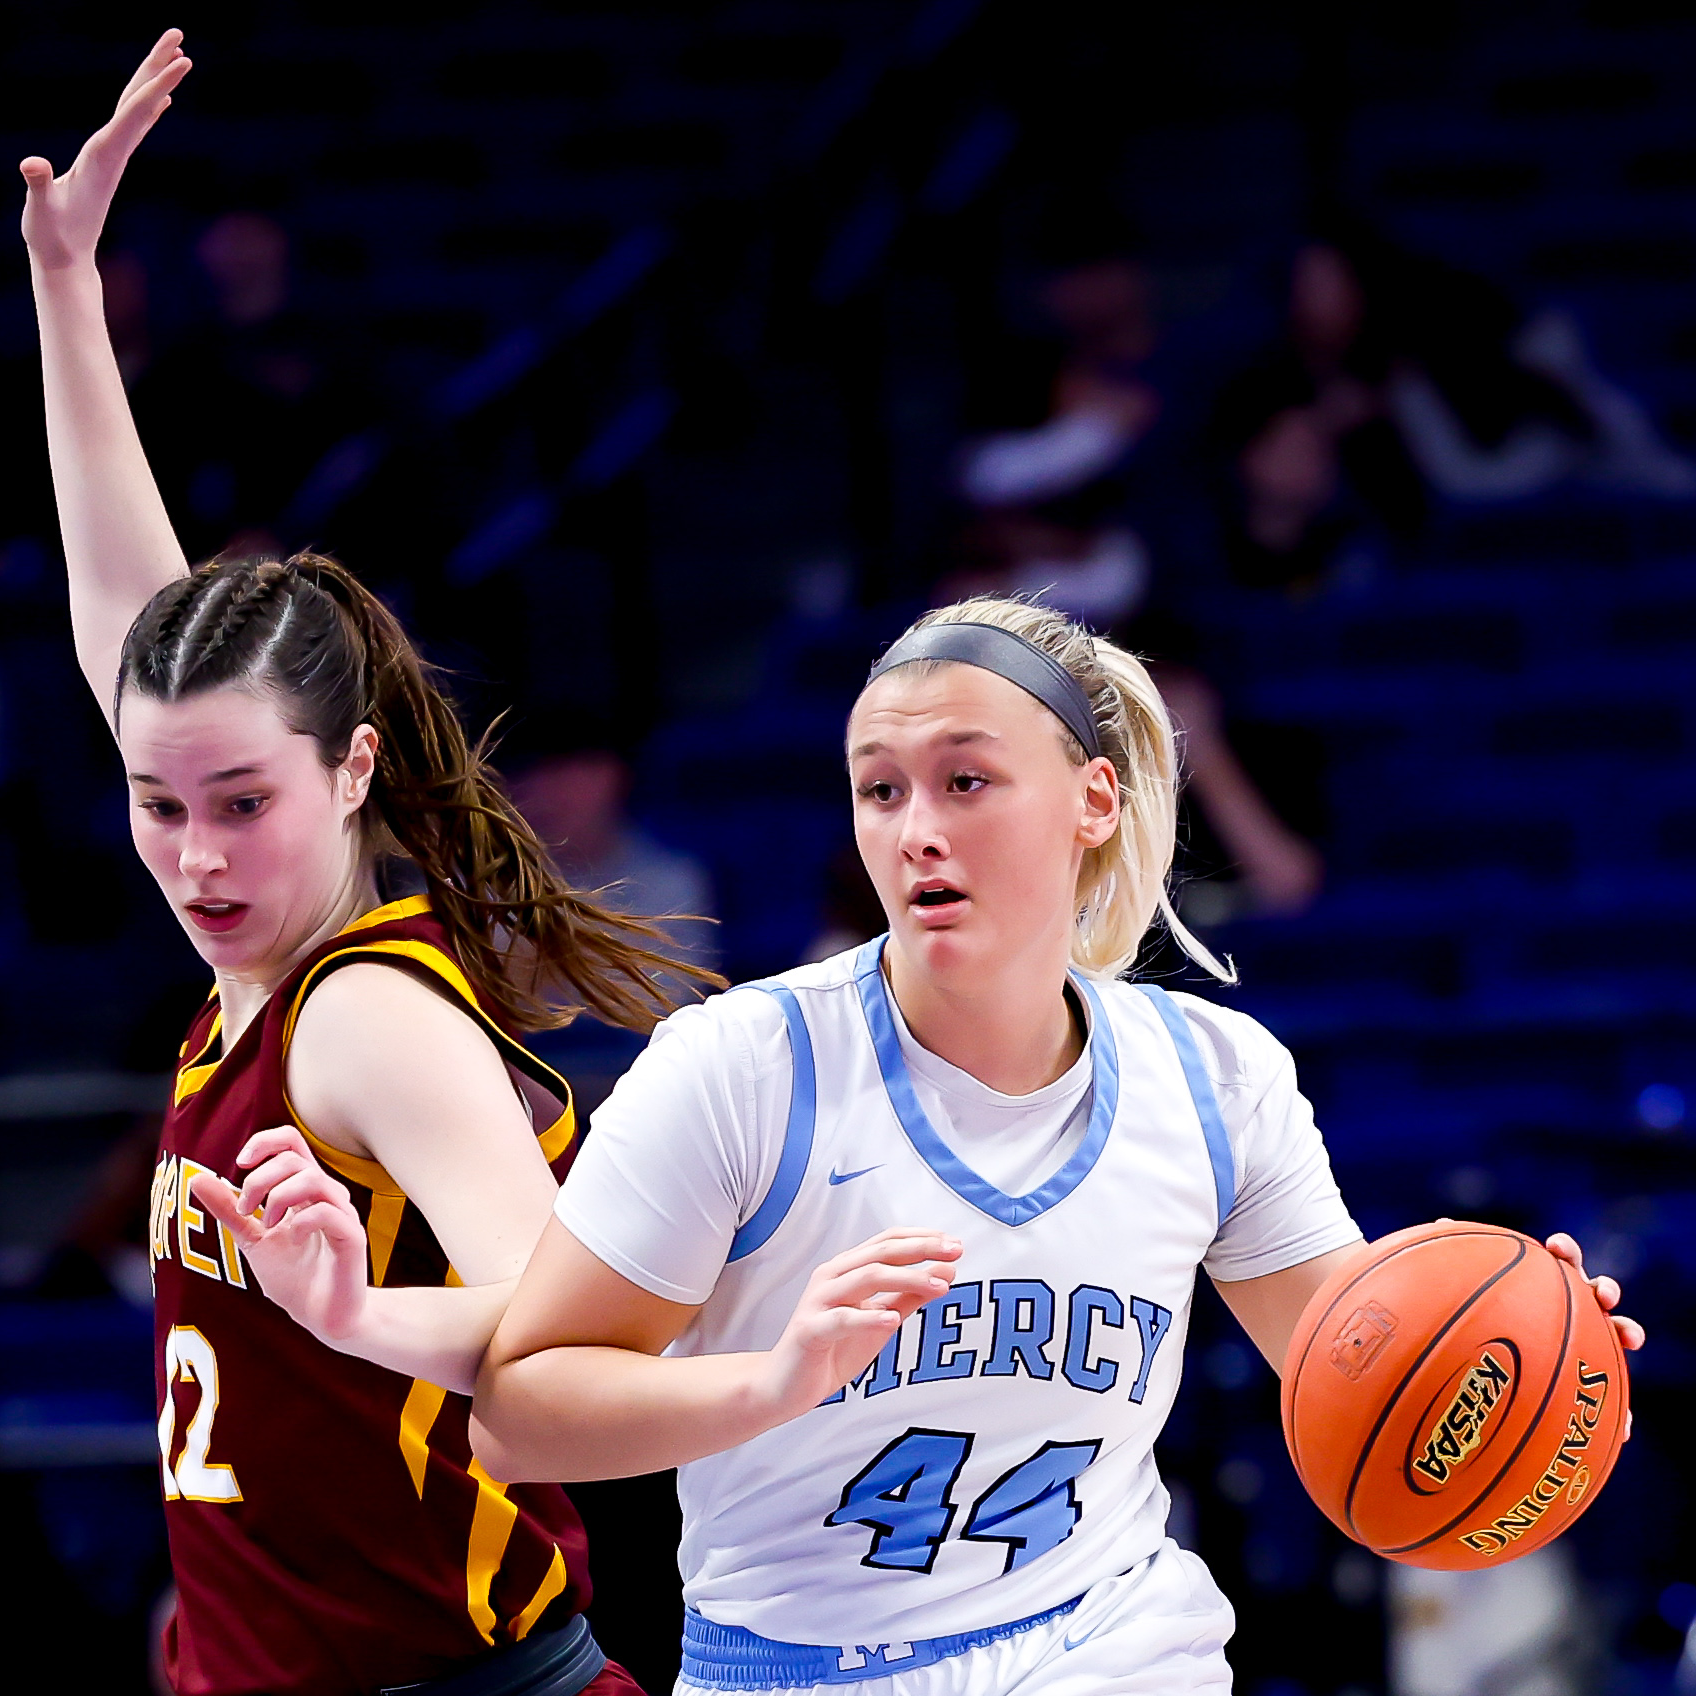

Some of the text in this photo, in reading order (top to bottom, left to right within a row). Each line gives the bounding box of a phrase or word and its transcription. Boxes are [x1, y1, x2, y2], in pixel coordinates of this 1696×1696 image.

[158, 1323, 244, 1504] 12
[1413, 1352, 1511, 1485] KHSAA
[1458, 1358, 1609, 1557] SPALDING
[823, 1427, 1104, 1576] 44
